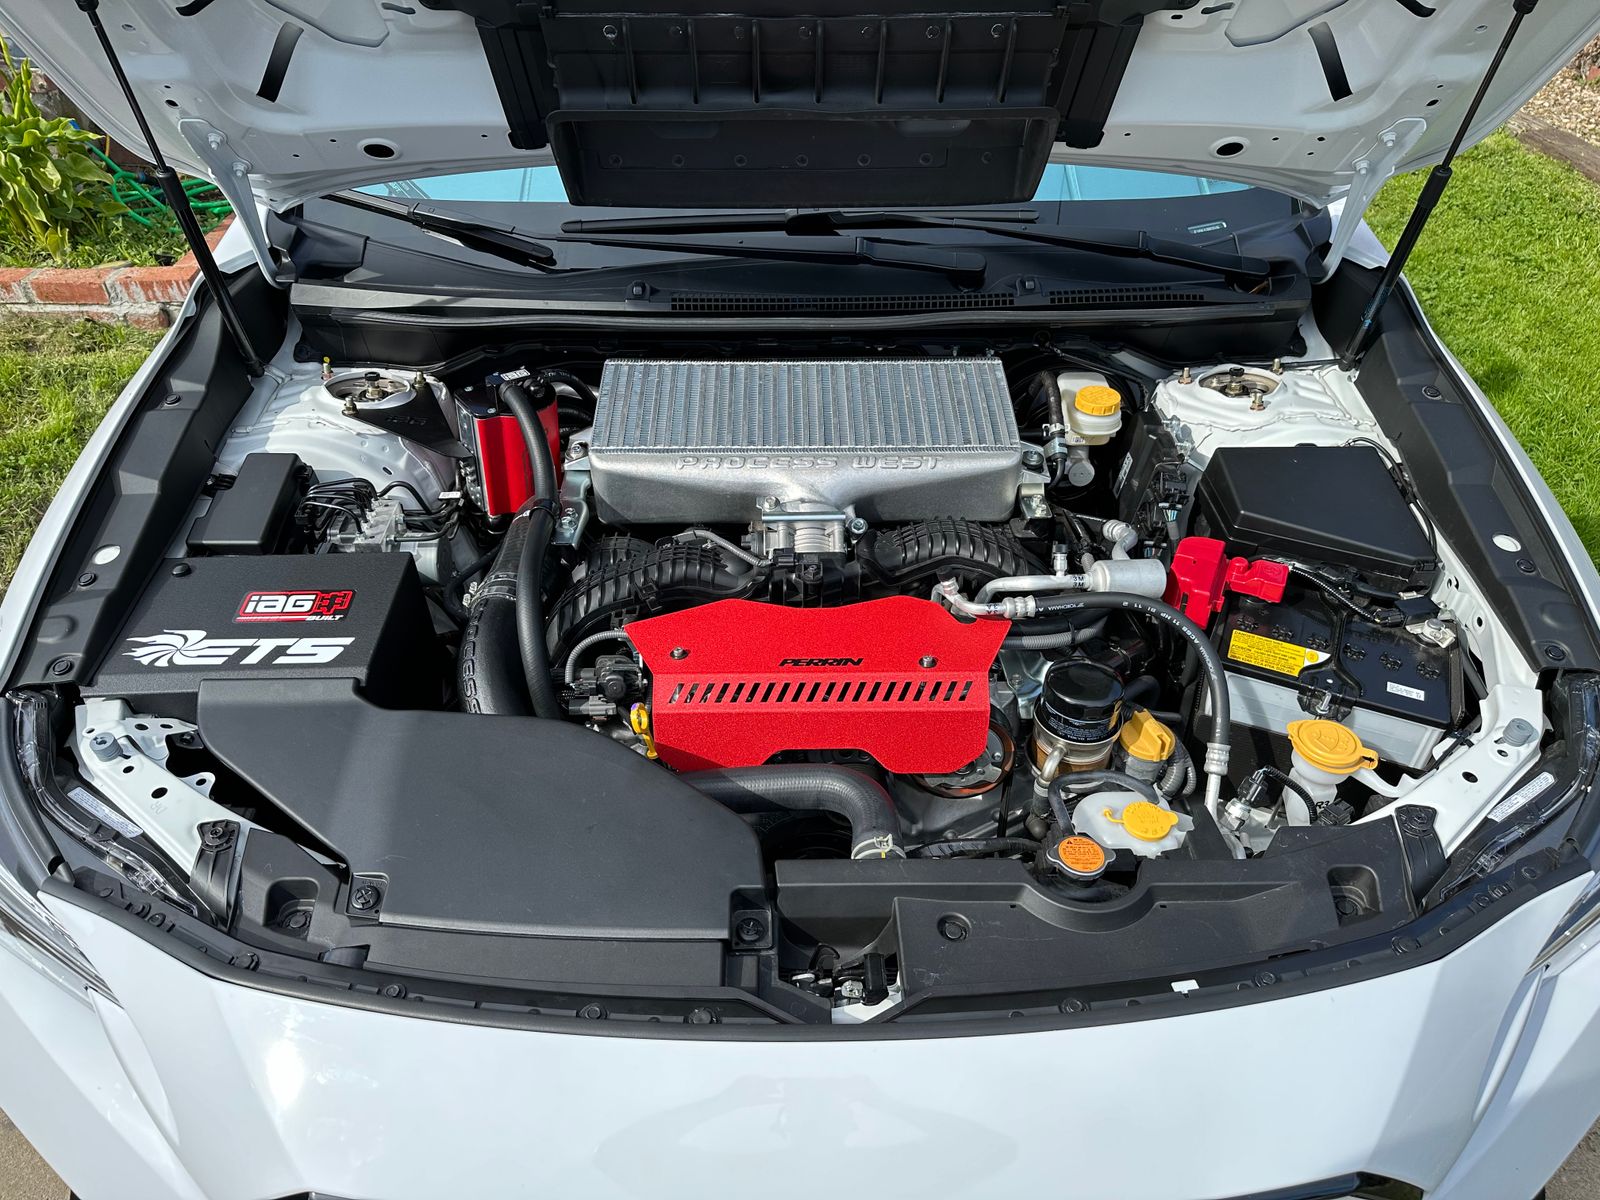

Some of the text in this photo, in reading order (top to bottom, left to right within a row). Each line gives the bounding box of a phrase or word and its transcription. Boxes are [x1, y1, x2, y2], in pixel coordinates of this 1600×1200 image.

[676, 456, 944, 470] PROCESS WEST
[172, 636, 355, 666] ETS
[779, 658, 864, 667] PERRIN
